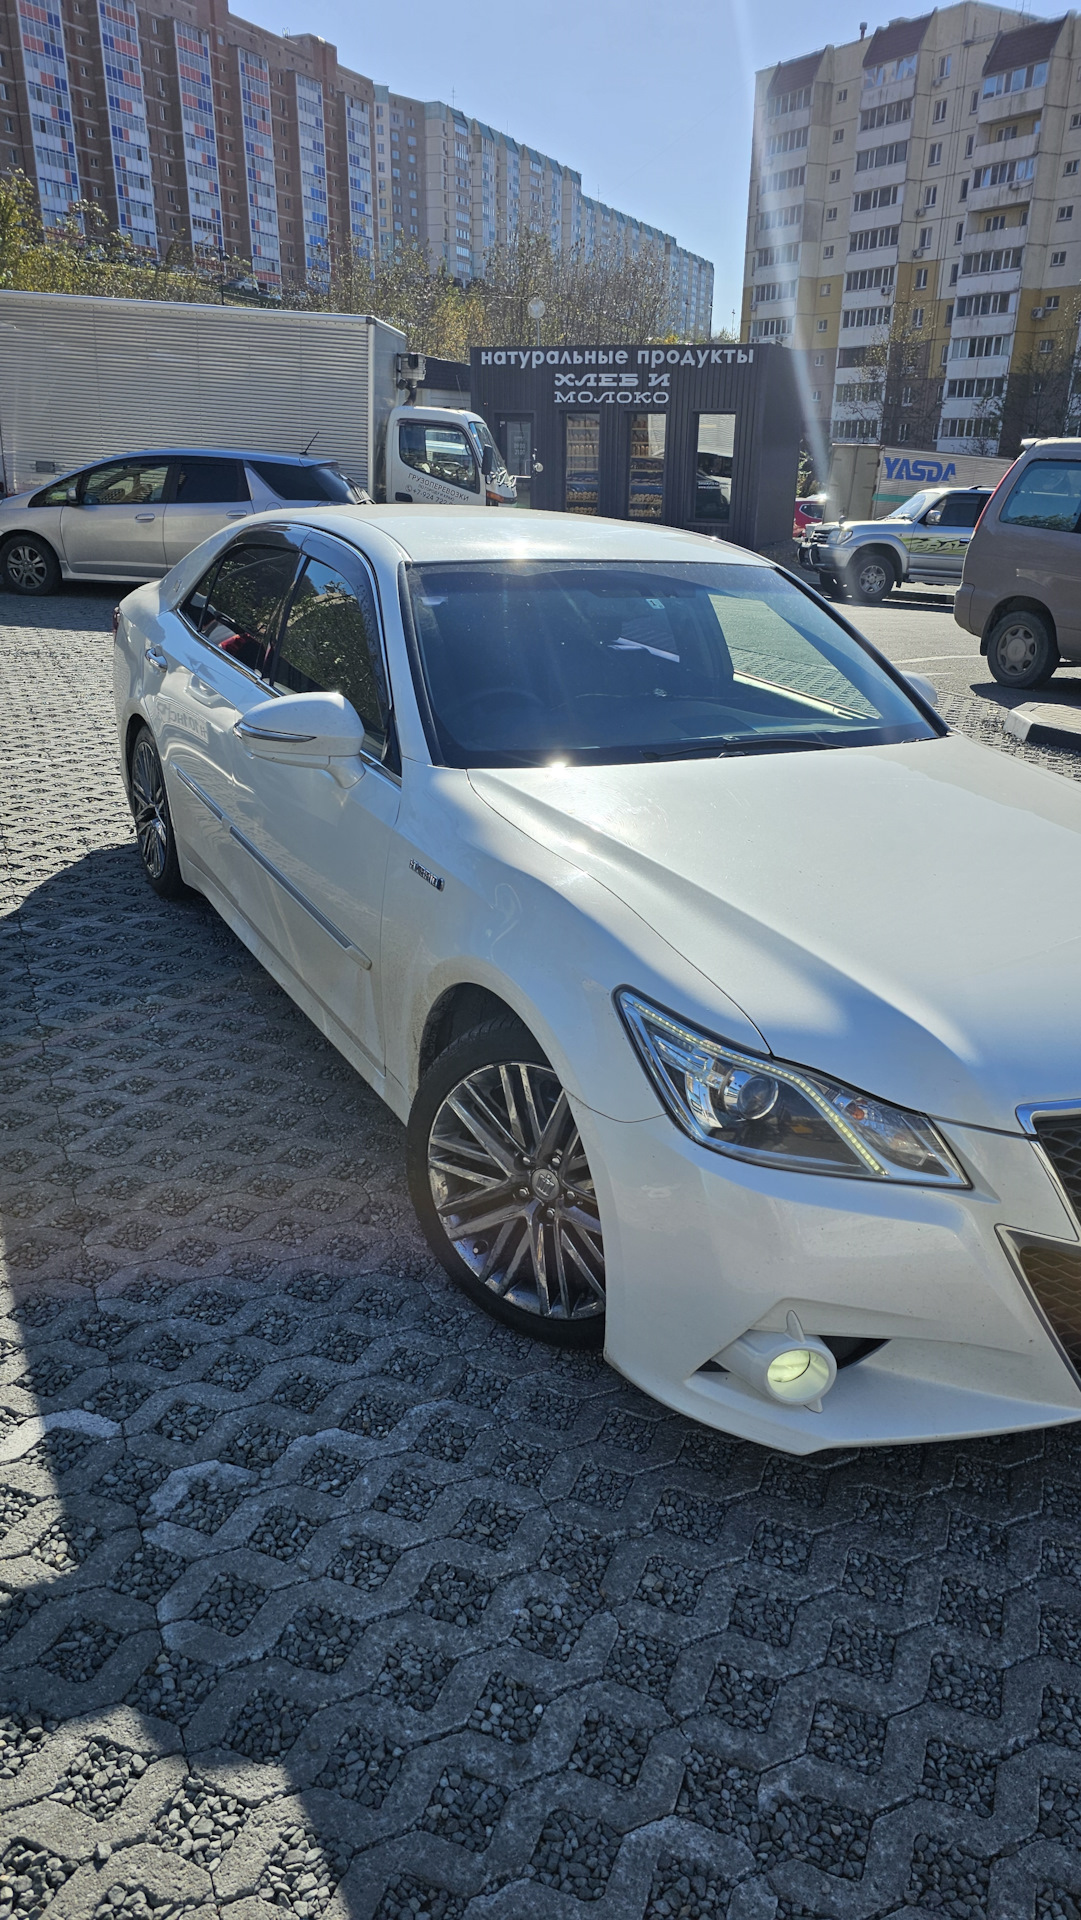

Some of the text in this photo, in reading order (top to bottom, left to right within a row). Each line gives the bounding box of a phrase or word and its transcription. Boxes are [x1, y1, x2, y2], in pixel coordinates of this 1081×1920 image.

[481, 349, 754, 369] натуральные продукты
[554, 373, 671, 387] ХЛЕБ И
[554, 391, 670, 404] МОЛОКО
[884, 456, 956, 482] YASDA
[408, 472, 470, 502] ГРУЗОПЕРЕВОЗКИ
[911, 540, 970, 552] PRAD
